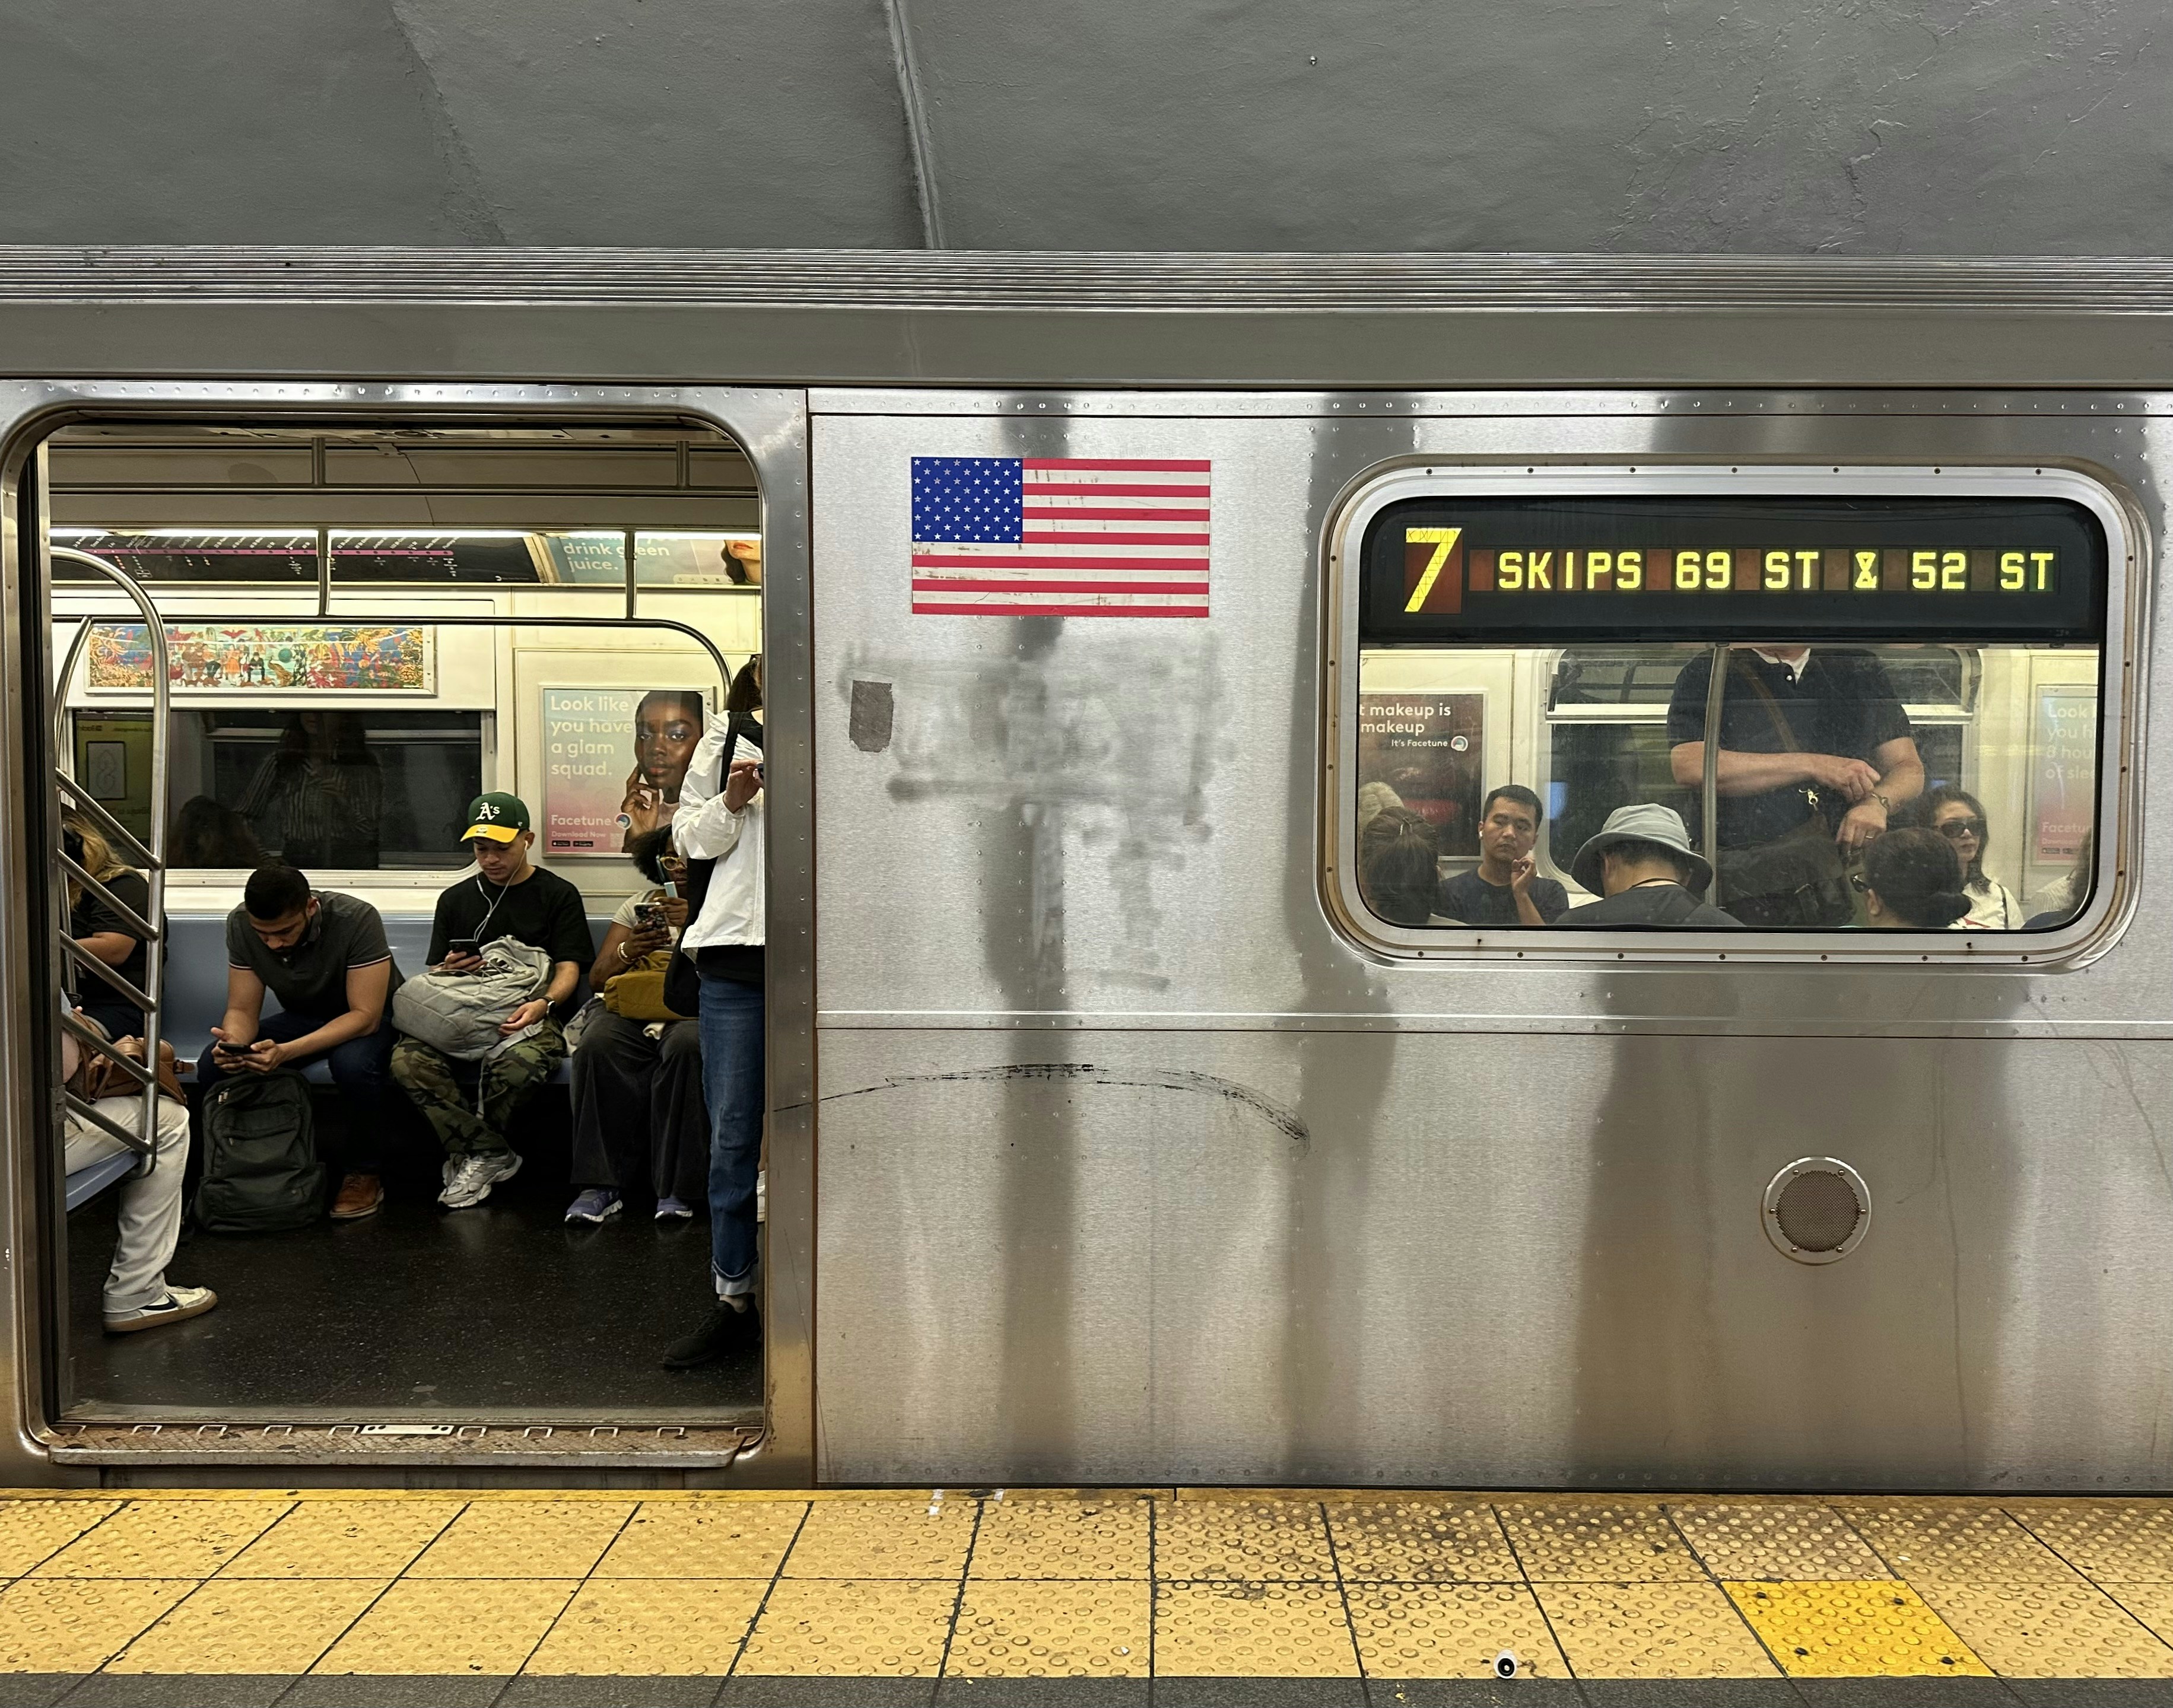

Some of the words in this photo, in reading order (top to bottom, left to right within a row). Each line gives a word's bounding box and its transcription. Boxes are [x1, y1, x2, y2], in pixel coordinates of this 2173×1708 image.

[564, 542, 613, 555] drink
[616, 546, 670, 559] geen
[567, 557, 618, 572] juice.
[1405, 528, 1462, 612] 7
[1499, 552, 1641, 589] SKIPS
[1676, 552, 1731, 589] 69
[1765, 552, 1819, 589] ST
[1855, 552, 1877, 589] &
[1912, 552, 1966, 589] 52
[2000, 552, 2054, 590] ST
[551, 695, 593, 711] Look
[598, 696, 629, 711] like
[1370, 703, 1434, 720] makeup
[1439, 702, 1451, 716] is
[2048, 703, 2088, 718] Look
[551, 721, 584, 736] you
[589, 718, 633, 733] have
[1361, 720, 1425, 736] makeup
[2047, 728, 2077, 743] you
[551, 743, 562, 753] a
[567, 739, 614, 758] glam
[551, 761, 612, 779] squad.
[2045, 765, 2064, 779] of
[475, 802, 500, 820] A's
[551, 815, 612, 826] Facetune
